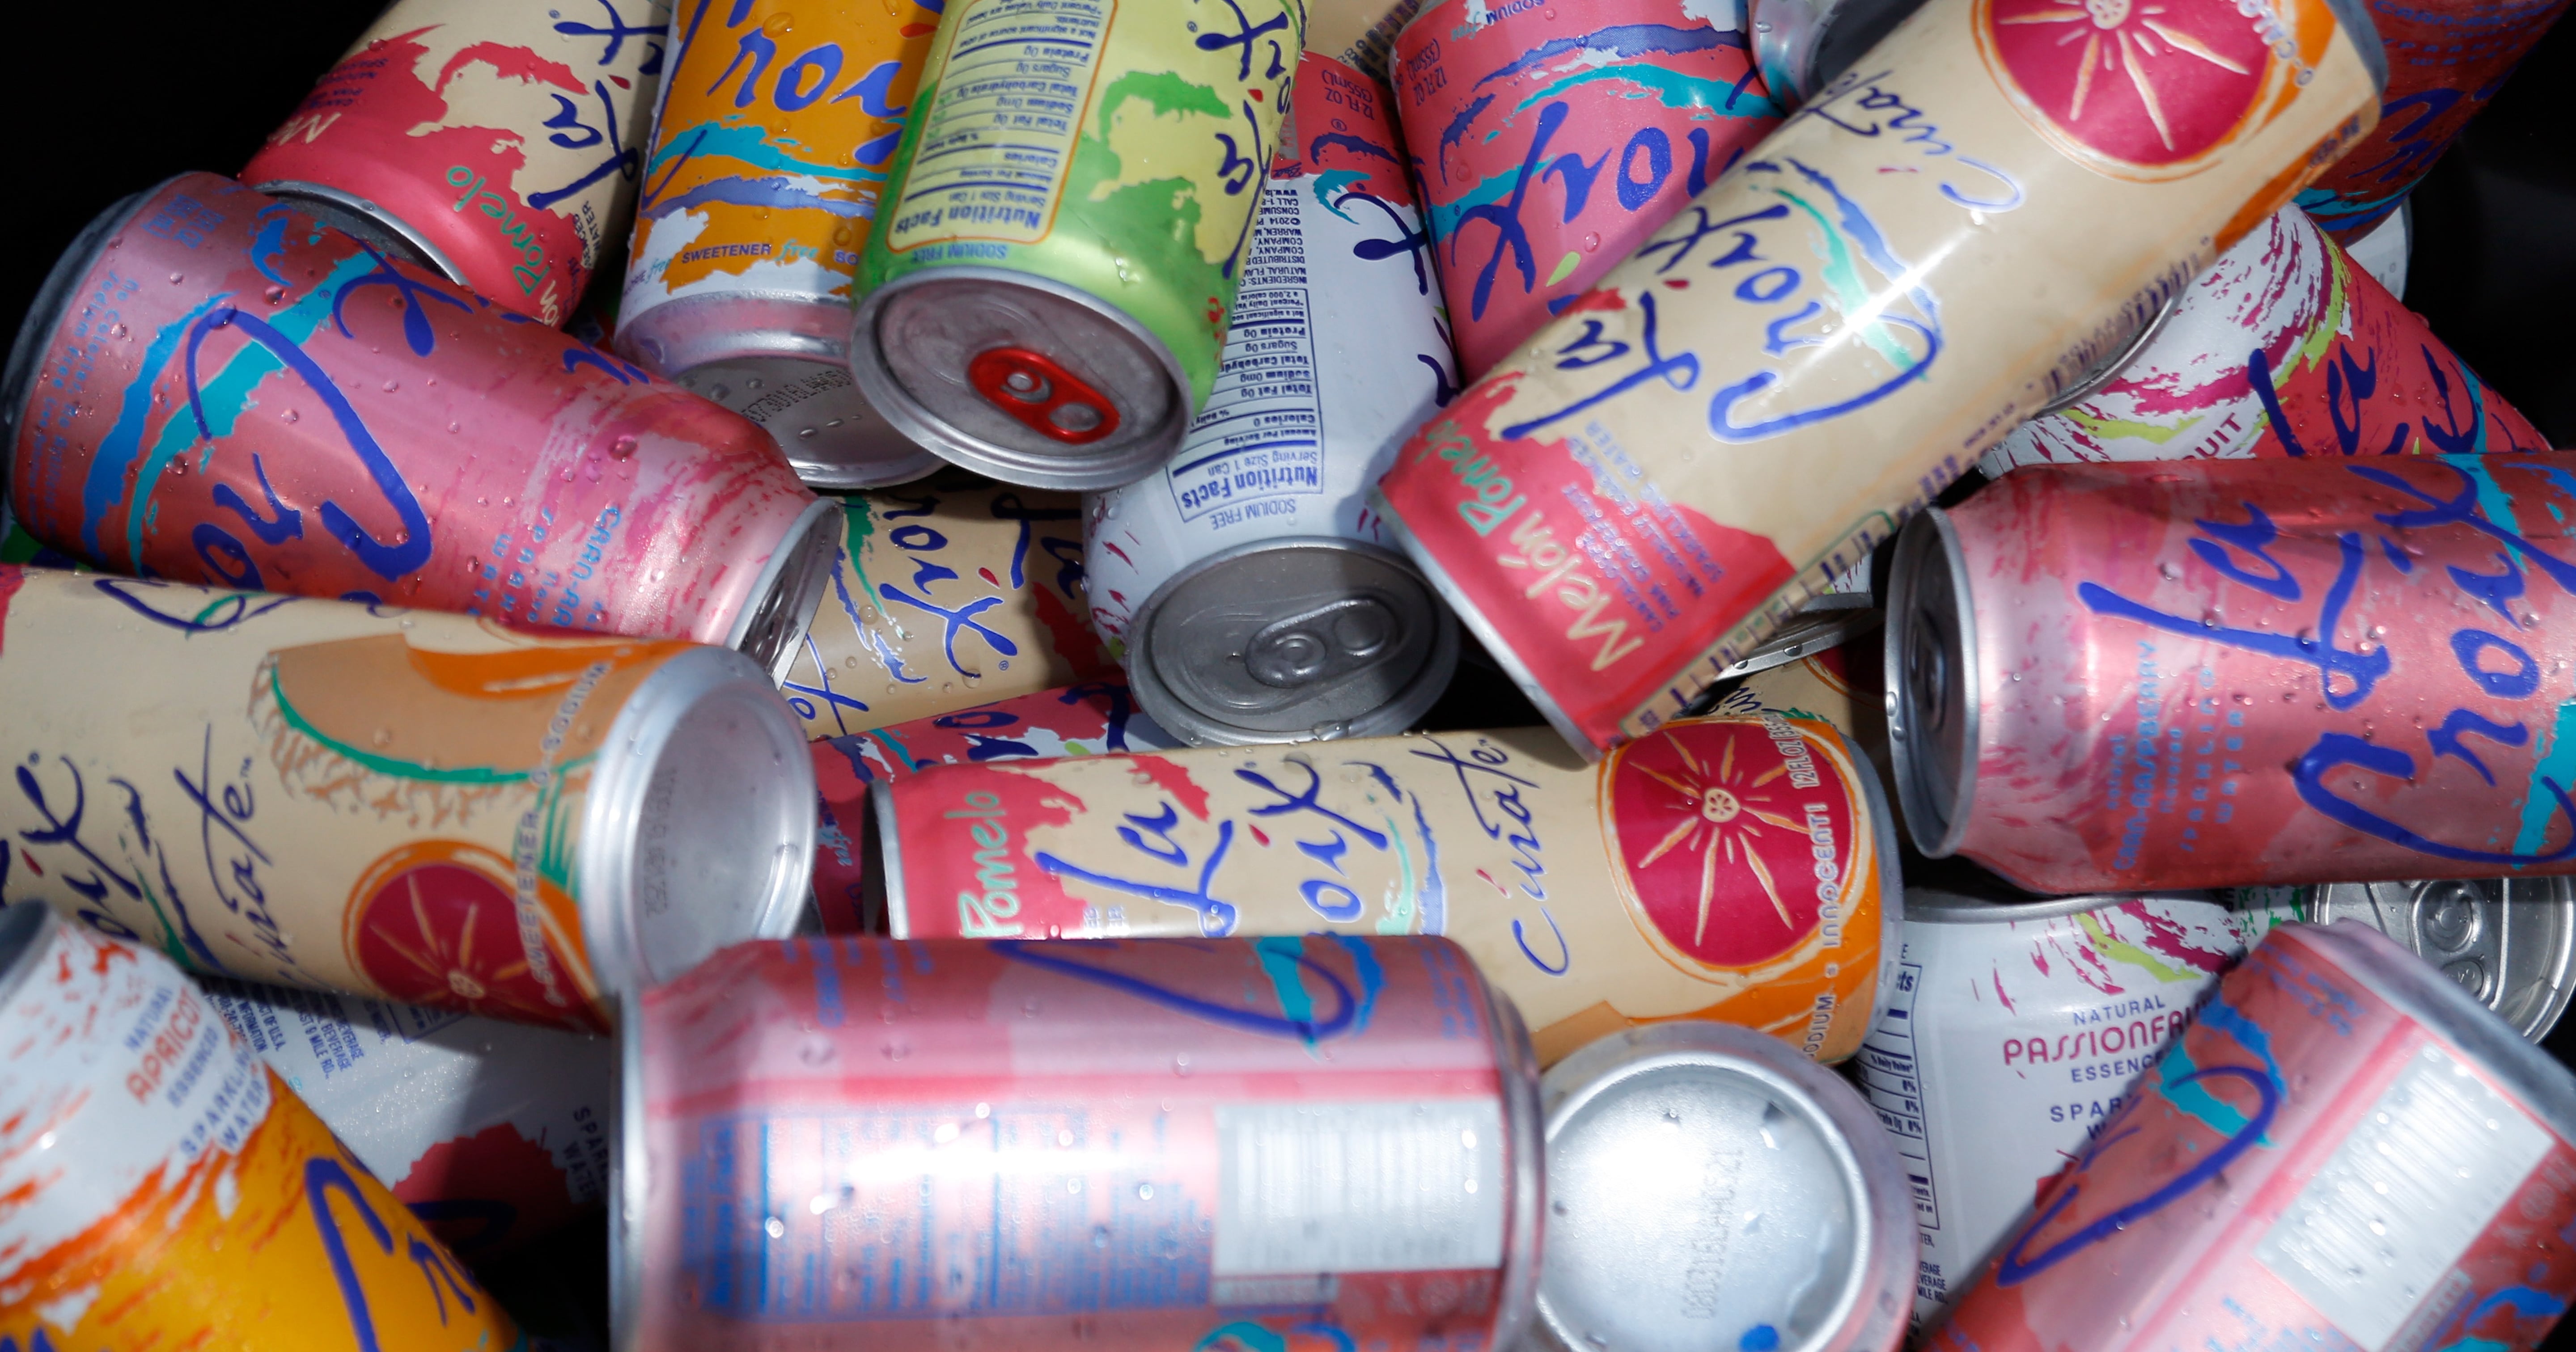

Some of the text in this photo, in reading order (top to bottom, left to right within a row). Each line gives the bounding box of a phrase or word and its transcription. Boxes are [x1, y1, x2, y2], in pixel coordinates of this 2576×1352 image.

[1024, 45, 1090, 65] Protein 0g
[1015, 61, 1072, 79] Sugars 0g
[1435, 65, 1448, 90] 12
[971, 80, 1047, 95] Carbohydrate
[1322, 69, 1373, 103] (355mL)
[1413, 80, 1426, 107] OZ
[1423, 77, 1435, 97] FL
[996, 96, 1024, 110] 0mg
[1324, 87, 1375, 121] 12 FL OZ
[993, 113, 1068, 131] Total Fat 0g
[1275, 198, 1299, 206] CALL
[894, 206, 1041, 234] Nutrition Facts
[447, 166, 551, 297] Pomelo
[1263, 227, 1302, 237] WARREN,
[681, 243, 772, 265] SWEETENER
[774, 238, 820, 262] free
[948, 244, 1008, 260] SODIUM
[1256, 245, 1304, 255] COMPANY,
[1252, 255, 1305, 264] DISTRIBUTED
[1248, 275, 1308, 285] INGREDIENTS:
[1267, 266, 1307, 276] NATURAL
[1241, 292, 1267, 301] calorie
[1268, 291, 1292, 299] 2,000
[1251, 300, 1269, 309] Daily
[1246, 309, 1285, 321] significant
[1244, 326, 1306, 339] Protein 0g
[1245, 340, 1298, 353] Sugars 0g
[1280, 355, 1310, 366] Total
[1240, 370, 1311, 383] Sodium 0mg
[1240, 384, 1313, 399] Total Fat 0g
[1253, 414, 1316, 427] Calories 0
[1224, 428, 1317, 446] Amount Per Serving
[2183, 412, 2242, 460] UIT
[1207, 451, 1318, 477] Serving Size 1 Can
[1181, 466, 1318, 510] Nutrition Facts
[1209, 498, 1296, 531] SODIUM FREE
[1775, 739, 1821, 790] 12 FL OZ
[2215, 709, 2246, 825] WATER
[943, 789, 1029, 937] Pomelo
[1804, 803, 1842, 949] INNOCENT!
[2072, 995, 2166, 1027] NATURAL
[237, 1000, 269, 1052] INFORMATION
[265, 1016, 278, 1030] OF
[306, 1026, 317, 1035] 9
[1802, 993, 1834, 1057] ODIUM
[126, 986, 201, 1107] APRICOT
[309, 1035, 329, 1060] MILE
[320, 1022, 353, 1073] BEVERAGE
[1902, 1079, 1916, 1093] 0%
[1904, 1099, 1919, 1113] 0%
[1907, 1120, 1922, 1134] 0%
